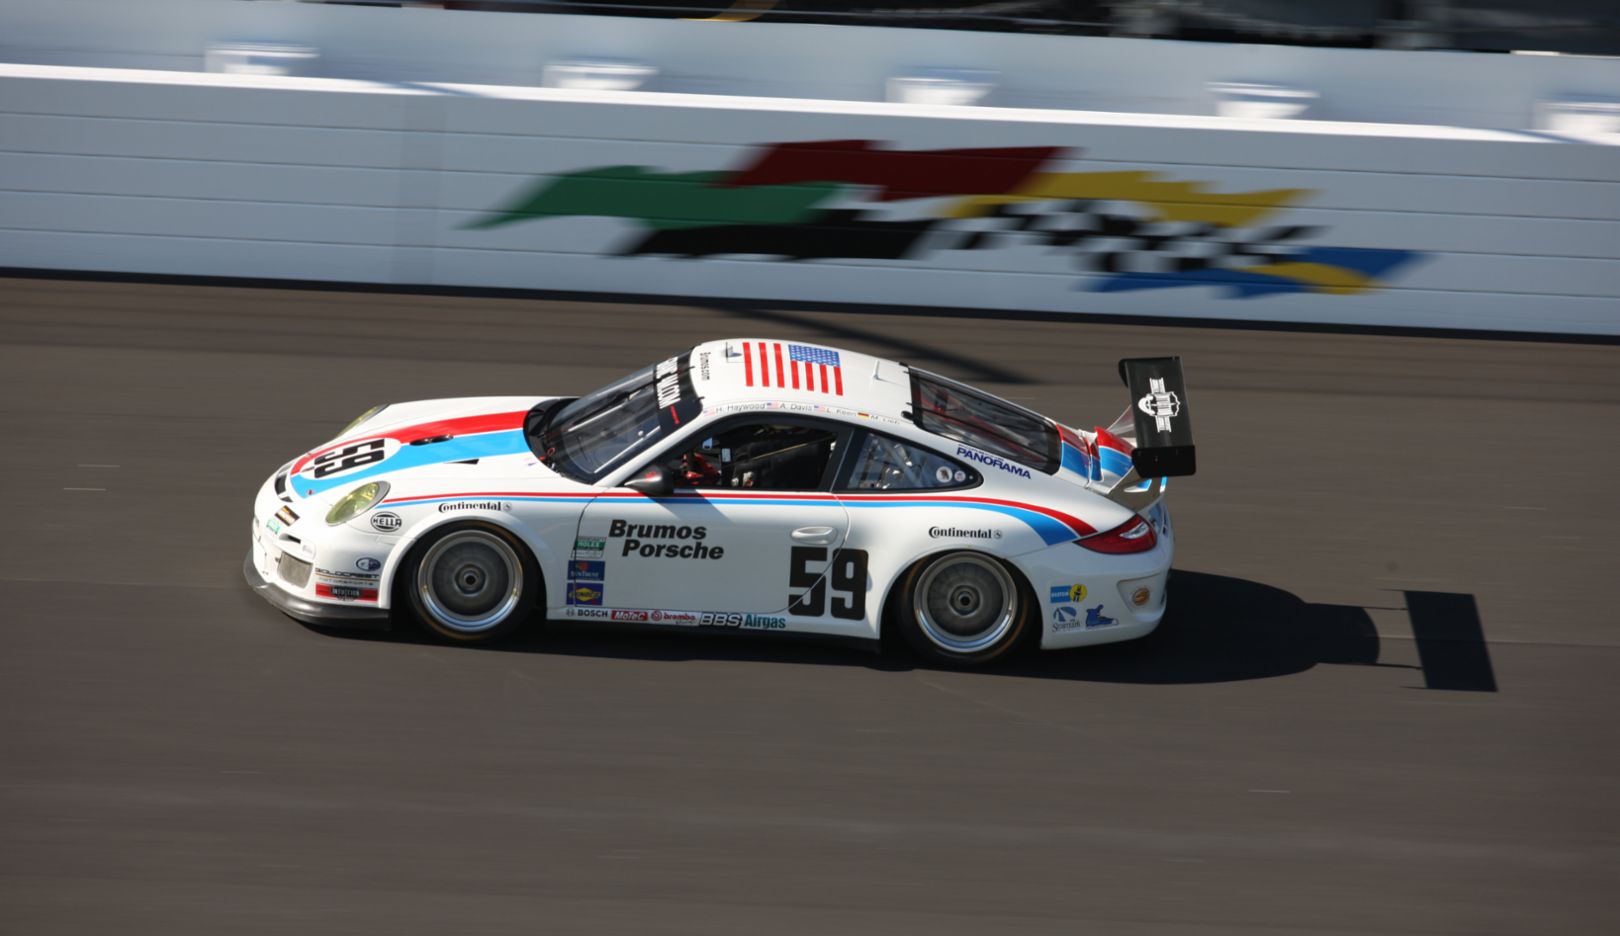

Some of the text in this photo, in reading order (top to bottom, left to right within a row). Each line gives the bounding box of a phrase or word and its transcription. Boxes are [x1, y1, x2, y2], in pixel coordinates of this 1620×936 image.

[727, 403, 766, 411] Haywood
[790, 403, 812, 411] Davis
[314, 438, 385, 479] 59
[956, 447, 1031, 480] PANORAMA
[438, 501, 502, 513] Continental
[373, 517, 402, 528] HELLA
[608, 519, 707, 540] Brumos
[928, 526, 992, 539] Continental
[622, 539, 724, 560] Porsche
[788, 546, 869, 621] 59
[577, 609, 608, 618] BOSCH
[664, 613, 696, 621] brembo
[700, 612, 741, 627] BBS
[744, 614, 786, 630] Airgas
